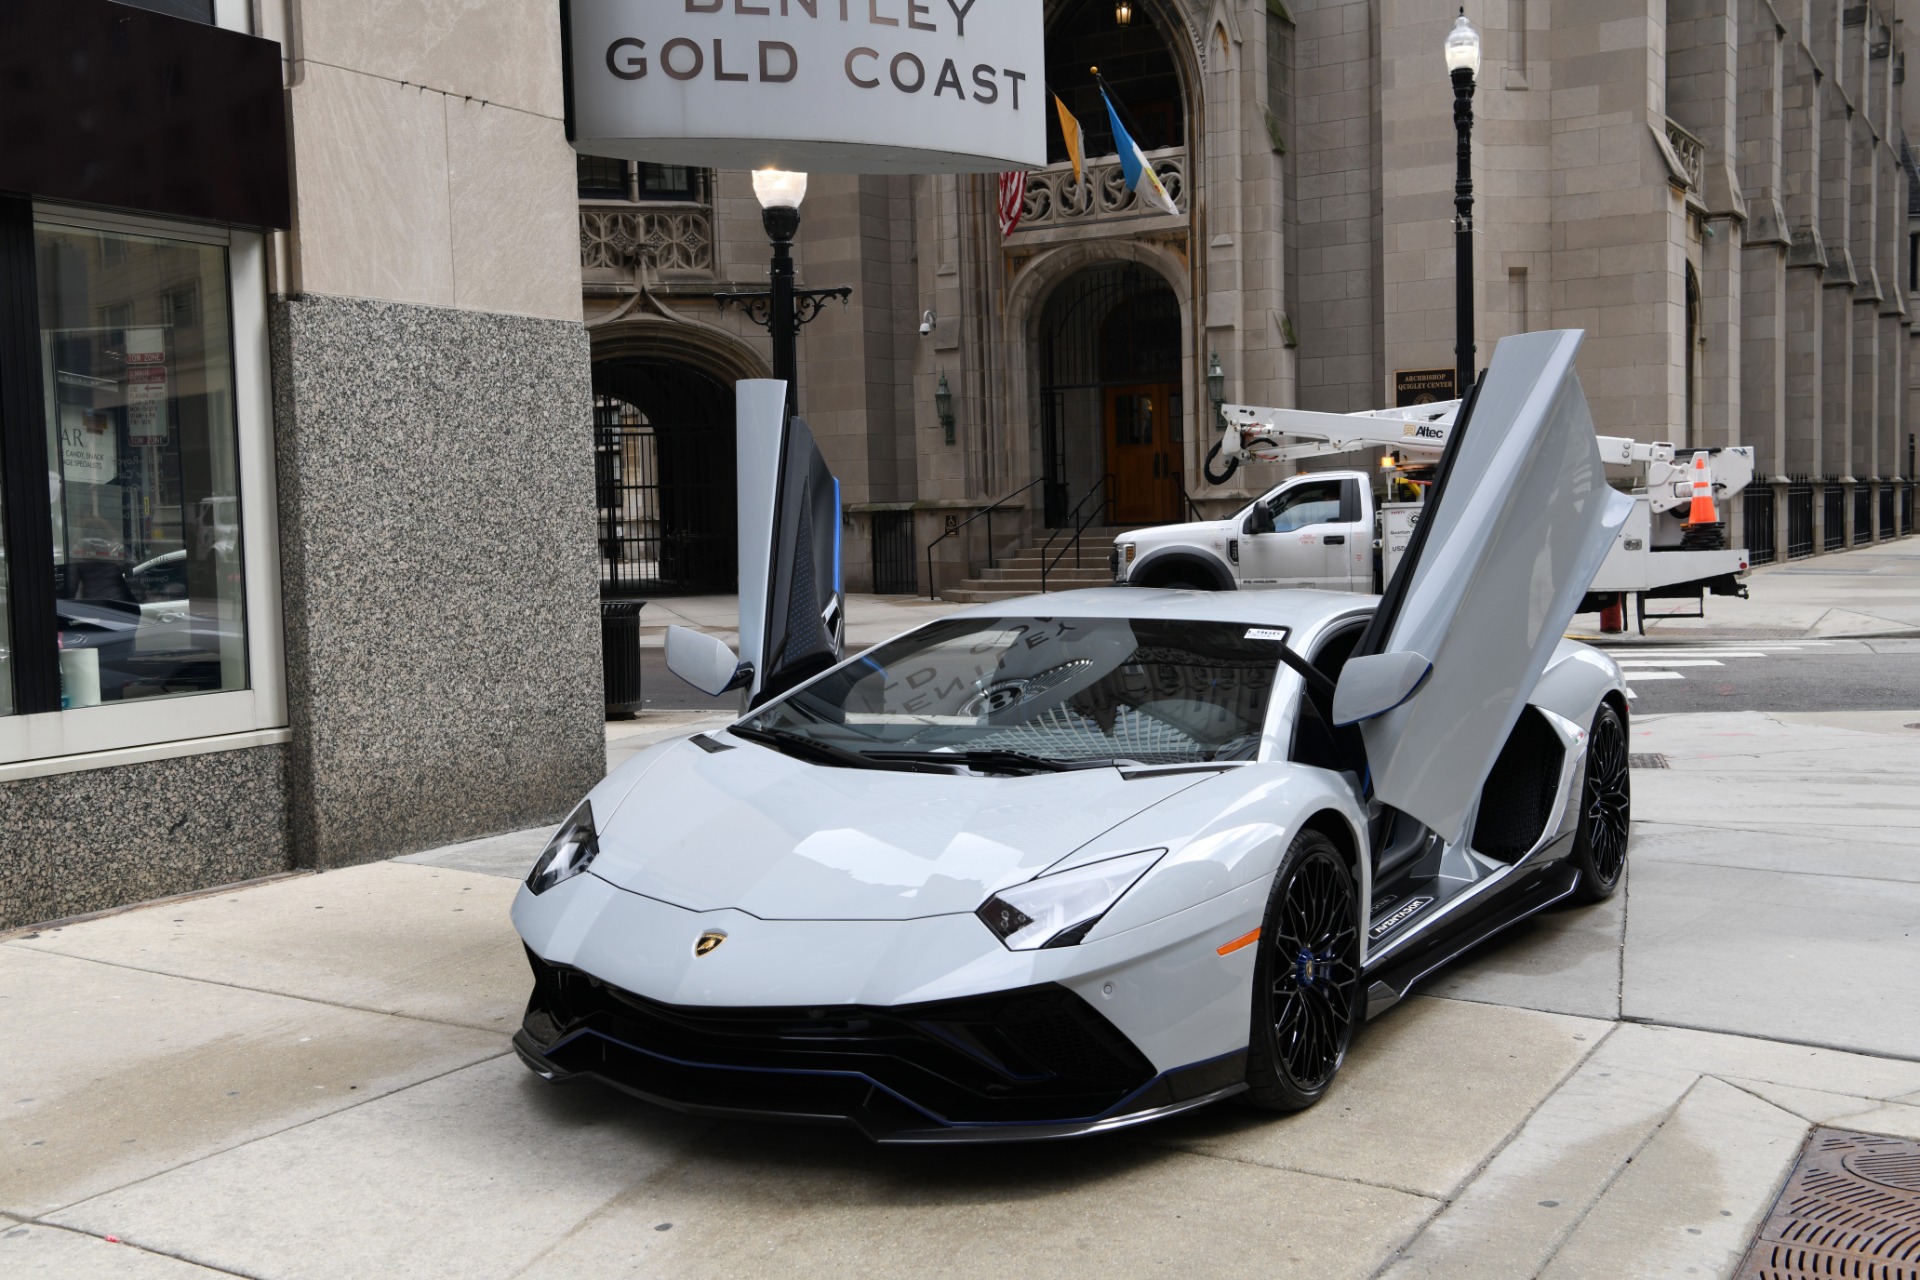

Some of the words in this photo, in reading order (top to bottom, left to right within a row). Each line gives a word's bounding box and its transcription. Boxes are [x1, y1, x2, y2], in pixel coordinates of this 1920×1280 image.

[606, 37, 798, 83] GOLD
[844, 47, 1026, 110] COAST
[144, 353, 161, 361] ZONE
[1405, 374, 1446, 382] ARCHBISHOP
[1398, 382, 1426, 391] QUIGLEY
[1426, 381, 1453, 389] CENTER
[1416, 426, 1443, 438] Altec
[1374, 900, 1424, 933] AVENTADOR
